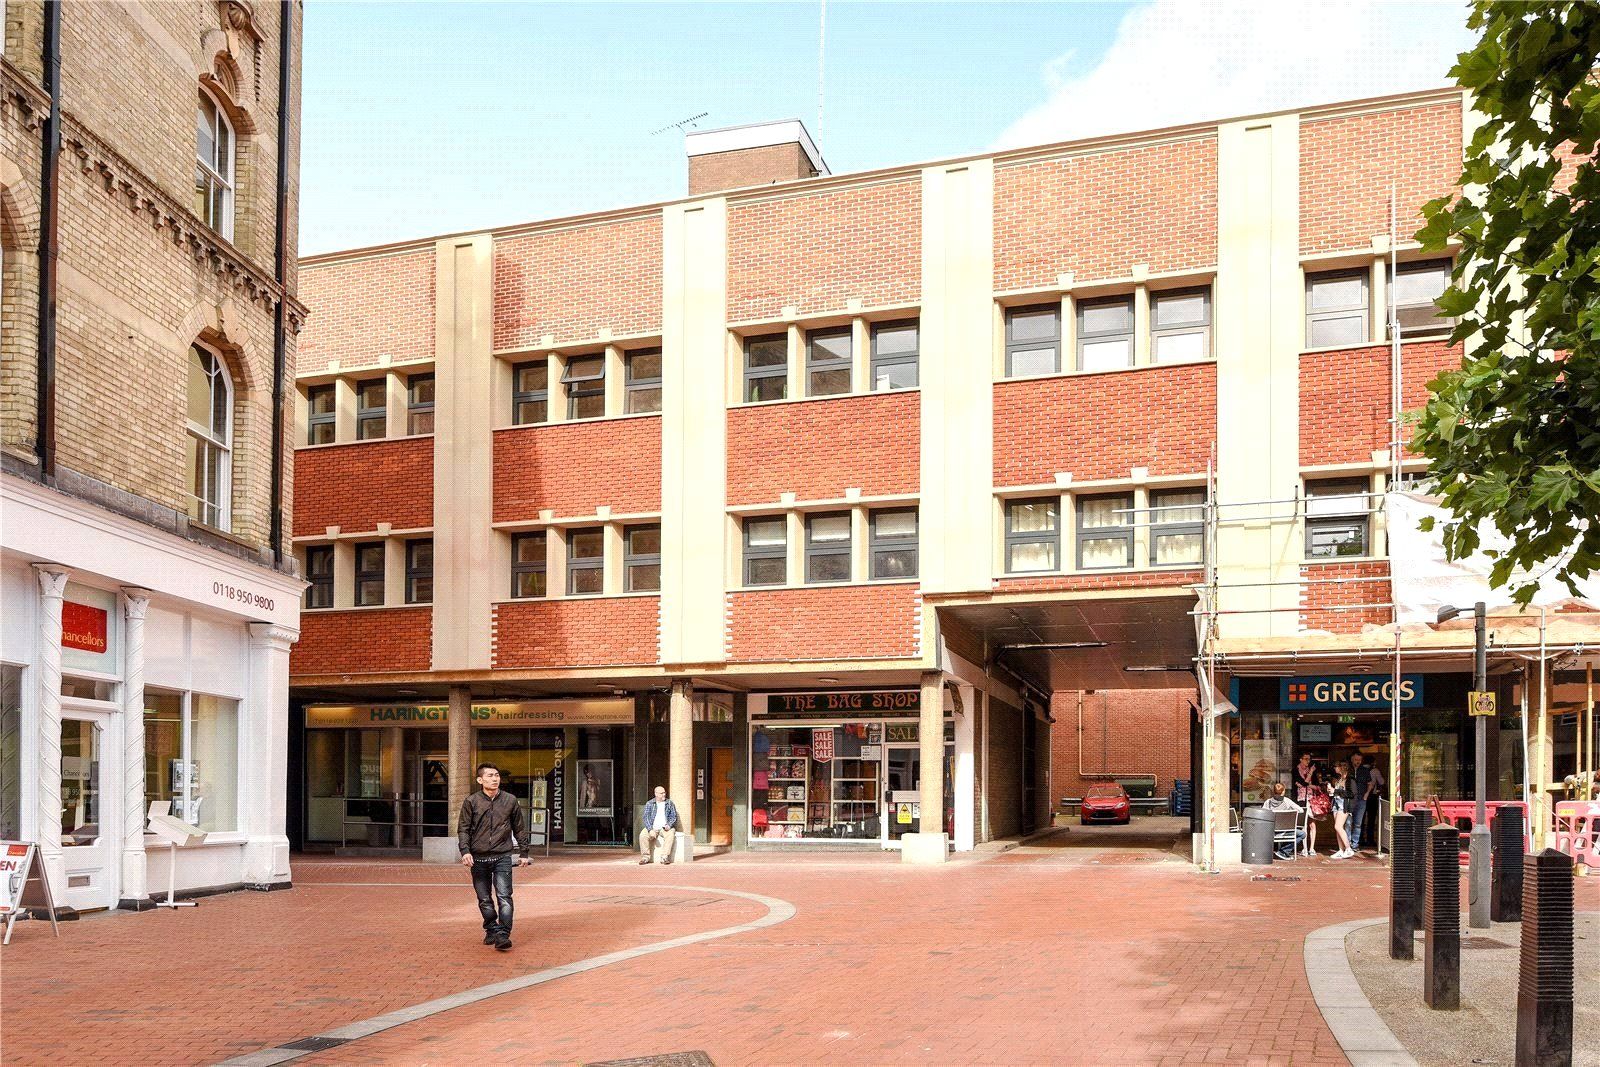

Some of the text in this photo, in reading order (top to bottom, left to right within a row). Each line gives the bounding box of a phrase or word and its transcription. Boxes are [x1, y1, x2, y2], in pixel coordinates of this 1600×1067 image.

[213, 581, 275, 611] 0118 950 9800
[62, 631, 104, 647] hancellors
[1313, 680, 1415, 702] GREGGS
[783, 692, 918, 712] THE BAG SHOP
[370, 706, 491, 721] HARINGTNS
[496, 710, 565, 720] hairdressing
[814, 732, 833, 741] SALE
[888, 727, 919, 740] SAL
[814, 741, 833, 750] SALE
[814, 749, 833, 759] SALE
[554, 739, 562, 829] HARINGTONS
